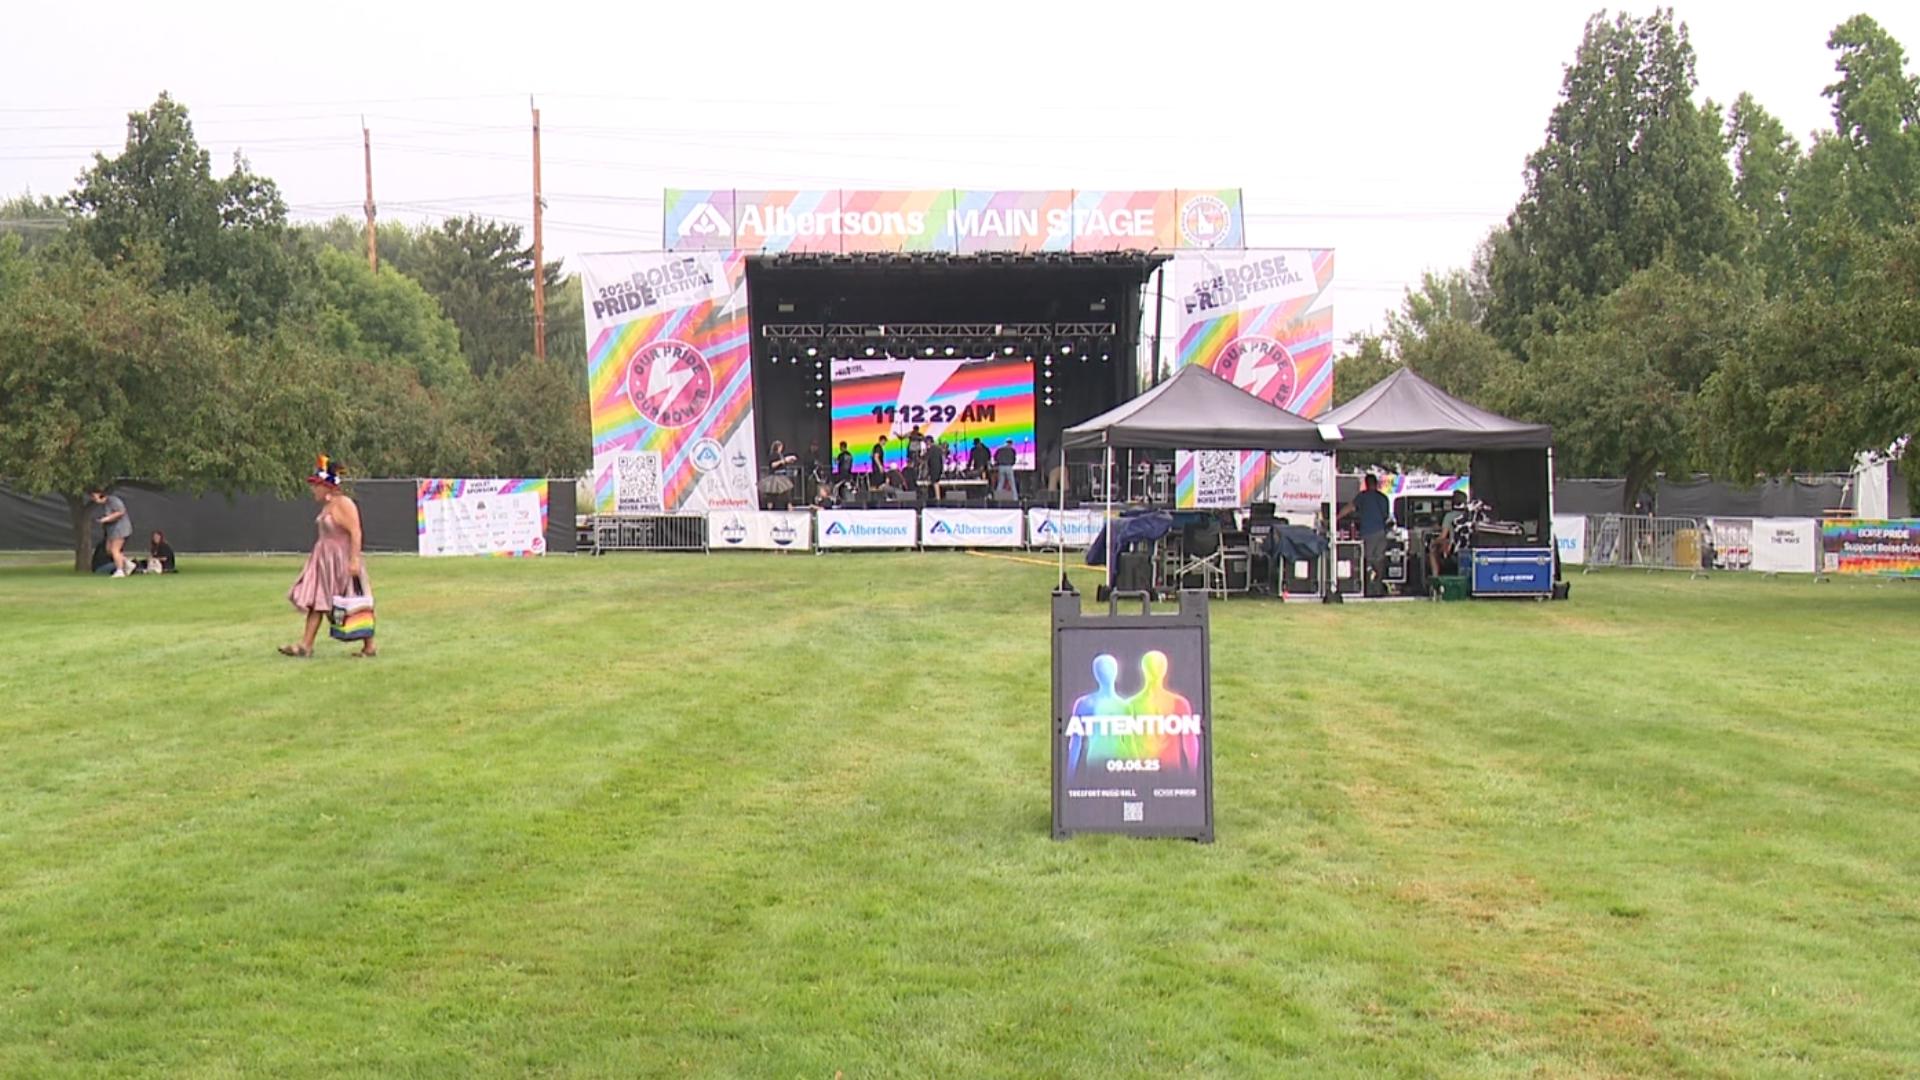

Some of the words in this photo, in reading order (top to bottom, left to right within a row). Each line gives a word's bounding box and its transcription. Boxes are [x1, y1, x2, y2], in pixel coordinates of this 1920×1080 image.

[738, 204, 924, 236] Albertsons
[947, 209, 1039, 236] MAIN
[1046, 208, 1155, 236] STAGE
[599, 281, 632, 298] 2025
[632, 258, 698, 290] BOISE
[1193, 276, 1225, 293] 2025
[1224, 255, 1288, 286] BOISE
[593, 286, 656, 319] PRIDE
[656, 273, 713, 298] FESTIVAL
[1184, 283, 1247, 315] PRIDE
[1246, 271, 1303, 294] FESTIVAL
[634, 349, 660, 375] OUR
[664, 346, 704, 375] PRIDE
[1222, 344, 1247, 369] OUR
[1251, 342, 1288, 370] PRIDE
[960, 404, 996, 423] AM
[848, 523, 907, 535] Albertsons
[952, 523, 1013, 535] Albertsons
[1843, 541, 1876, 553] Support
[1066, 714, 1200, 737] ATTENTION
